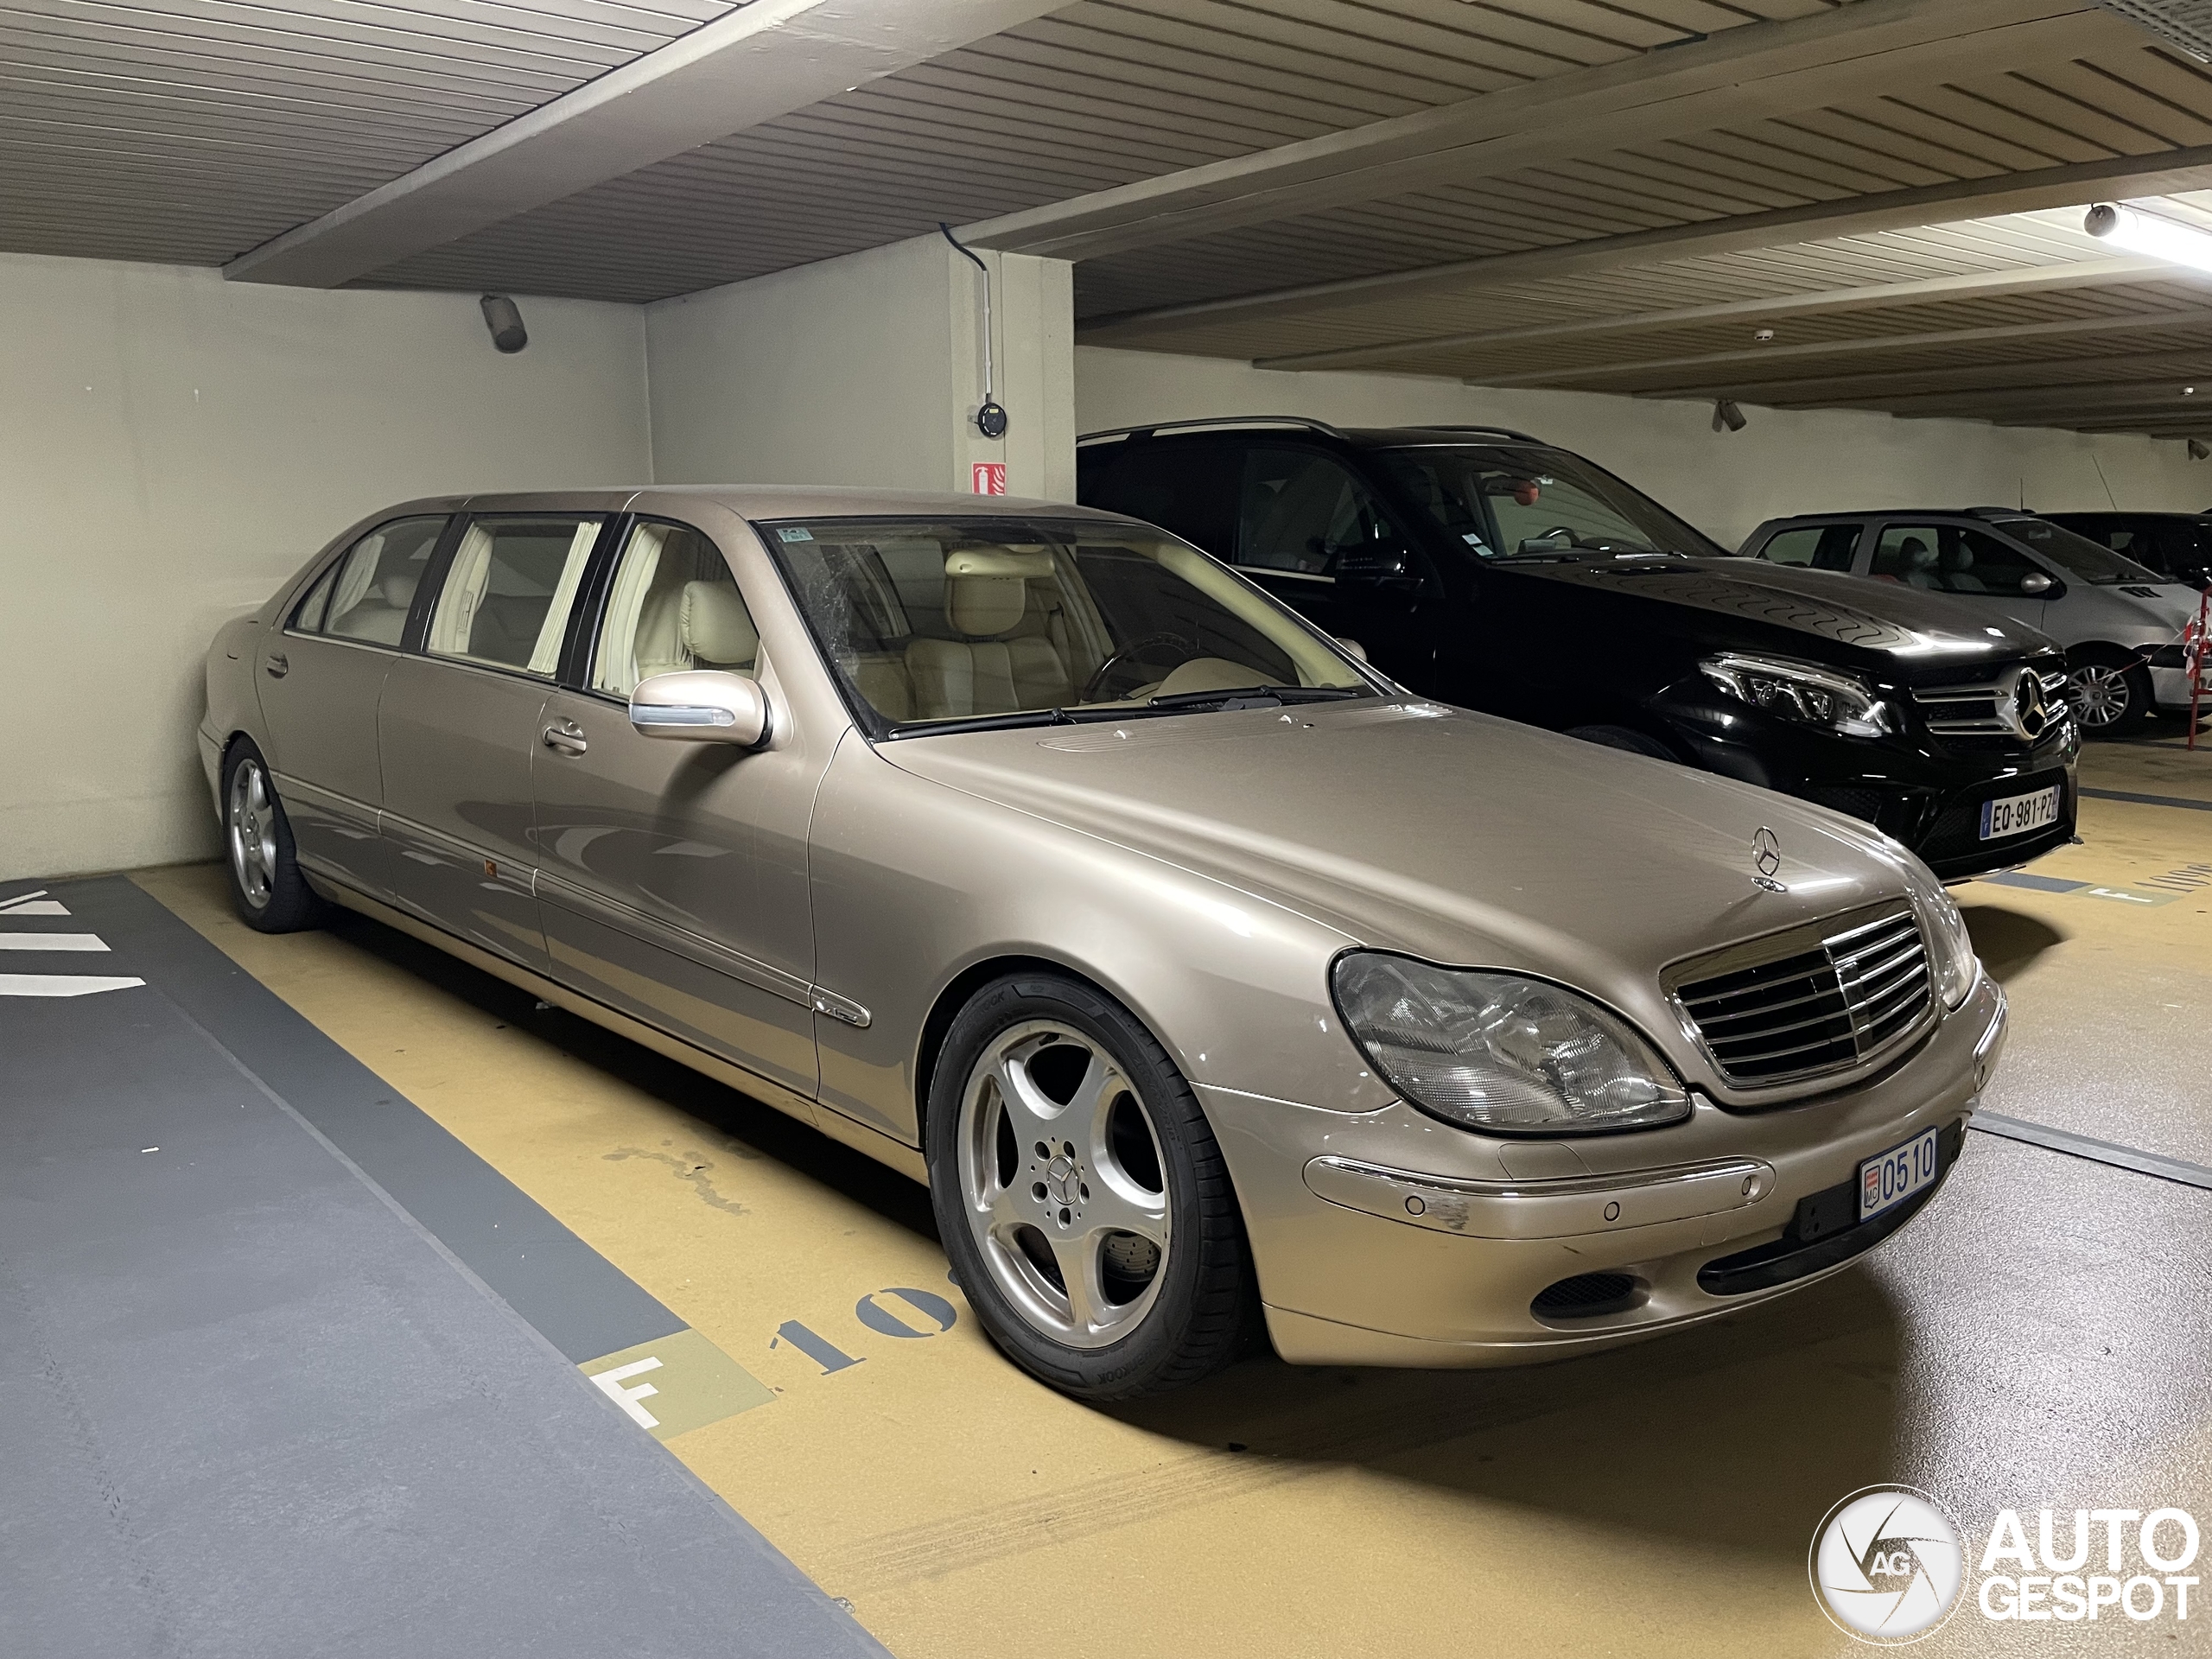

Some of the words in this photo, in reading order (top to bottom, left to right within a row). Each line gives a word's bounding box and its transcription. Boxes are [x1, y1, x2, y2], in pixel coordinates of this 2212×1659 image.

[1867, 1187, 1878, 1203] MC
[1883, 1137, 1933, 1200] 0510
[770, 1266, 961, 1376] 10
